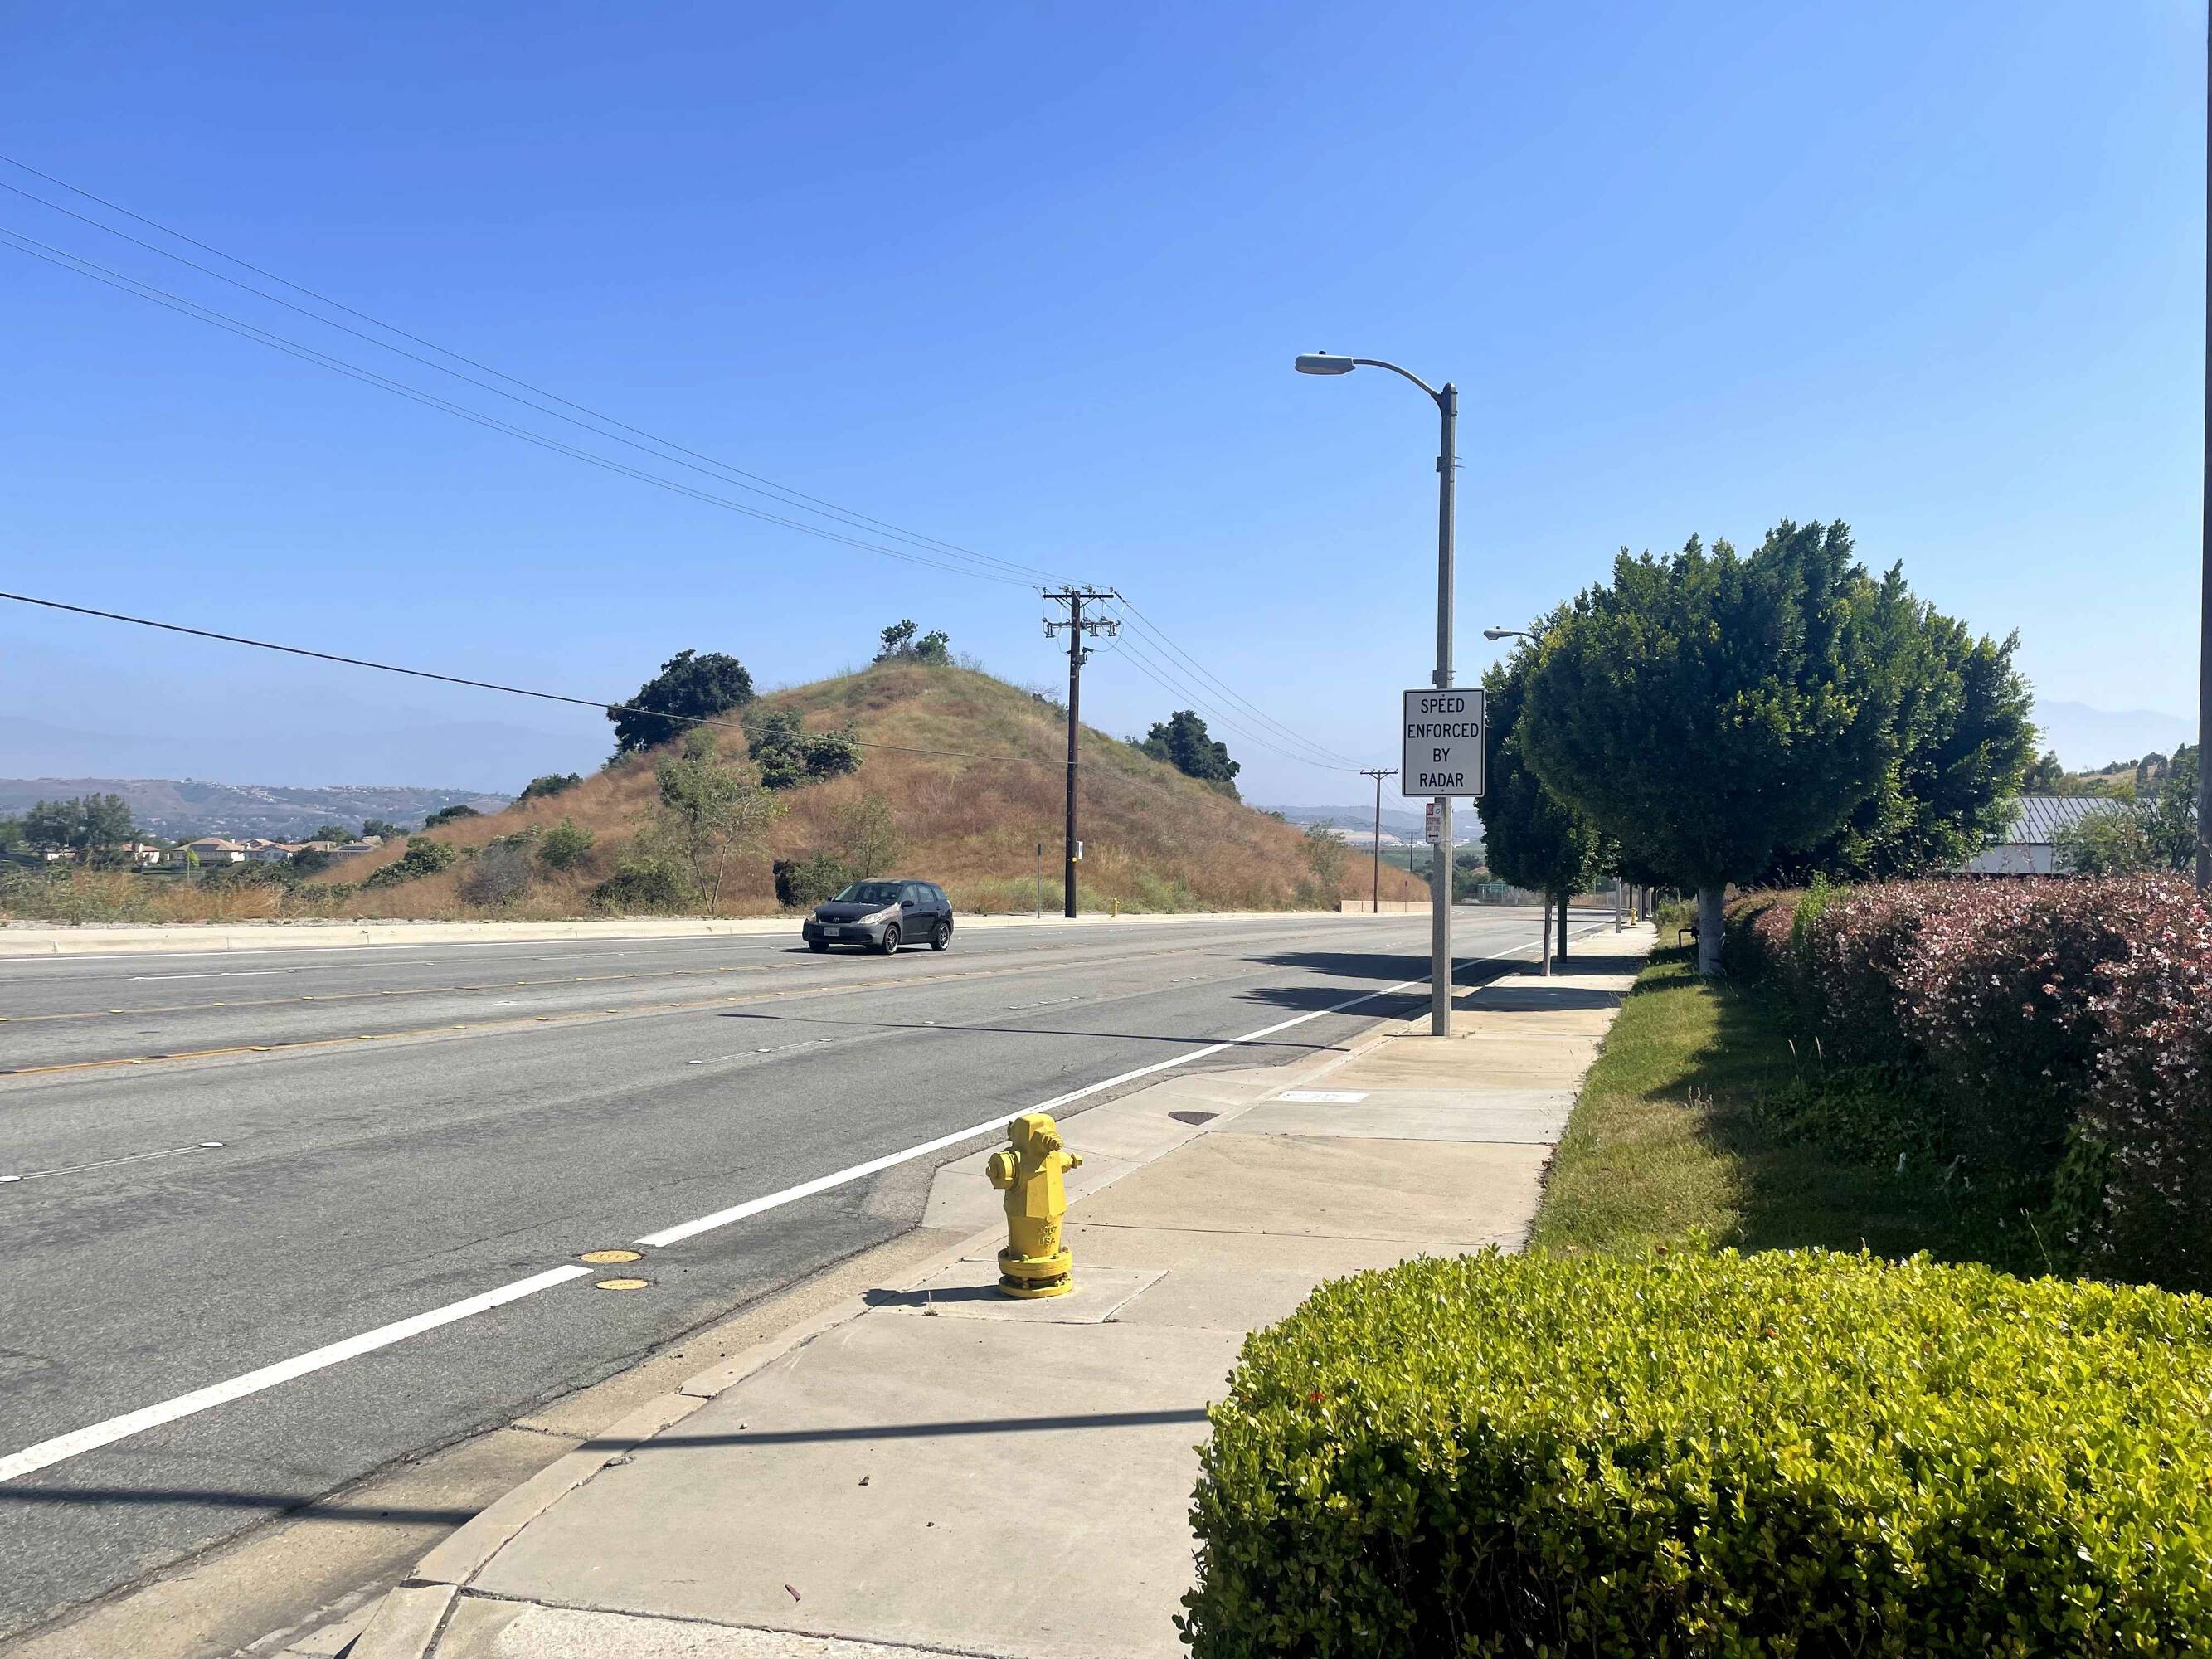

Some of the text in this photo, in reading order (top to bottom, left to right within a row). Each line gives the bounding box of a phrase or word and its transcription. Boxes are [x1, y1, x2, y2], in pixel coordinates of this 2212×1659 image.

[1421, 698, 1465, 713] SPEED
[1407, 723, 1479, 738] ENFORCED
[1433, 748, 1451, 762] BY
[1419, 773, 1464, 787] RADAR
[1038, 1235, 1056, 1246] USA
